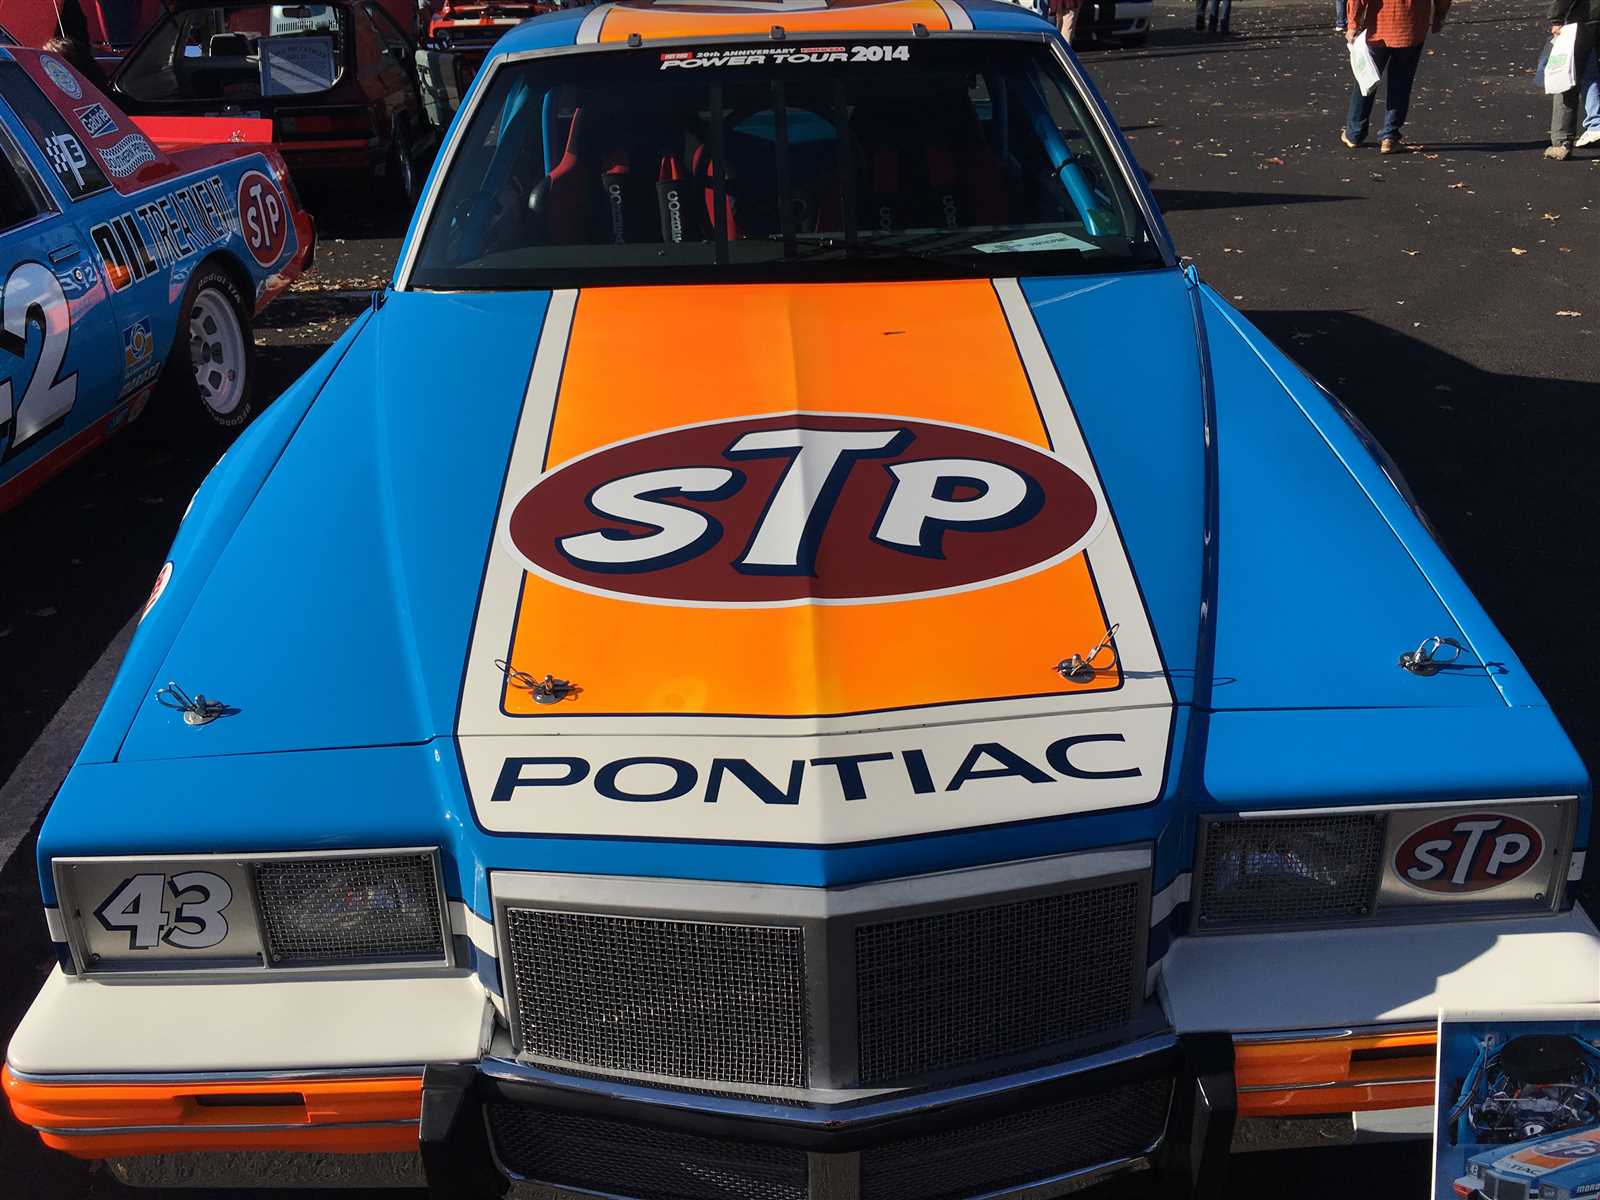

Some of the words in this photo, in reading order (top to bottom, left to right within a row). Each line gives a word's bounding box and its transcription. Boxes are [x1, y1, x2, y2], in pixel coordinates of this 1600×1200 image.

[660, 54, 767, 70] POWER
[773, 52, 849, 64] TOUR
[722, 47, 796, 57] ANNIVERSARY
[850, 45, 910, 62] 2014
[90, 211, 160, 293] OIL
[135, 175, 237, 269] TREATMENT
[246, 183, 280, 248] STP
[556, 428, 1044, 577] STP
[490, 733, 1142, 805] PONTIAC
[1406, 818, 1532, 886] STP
[93, 870, 233, 950] 43
